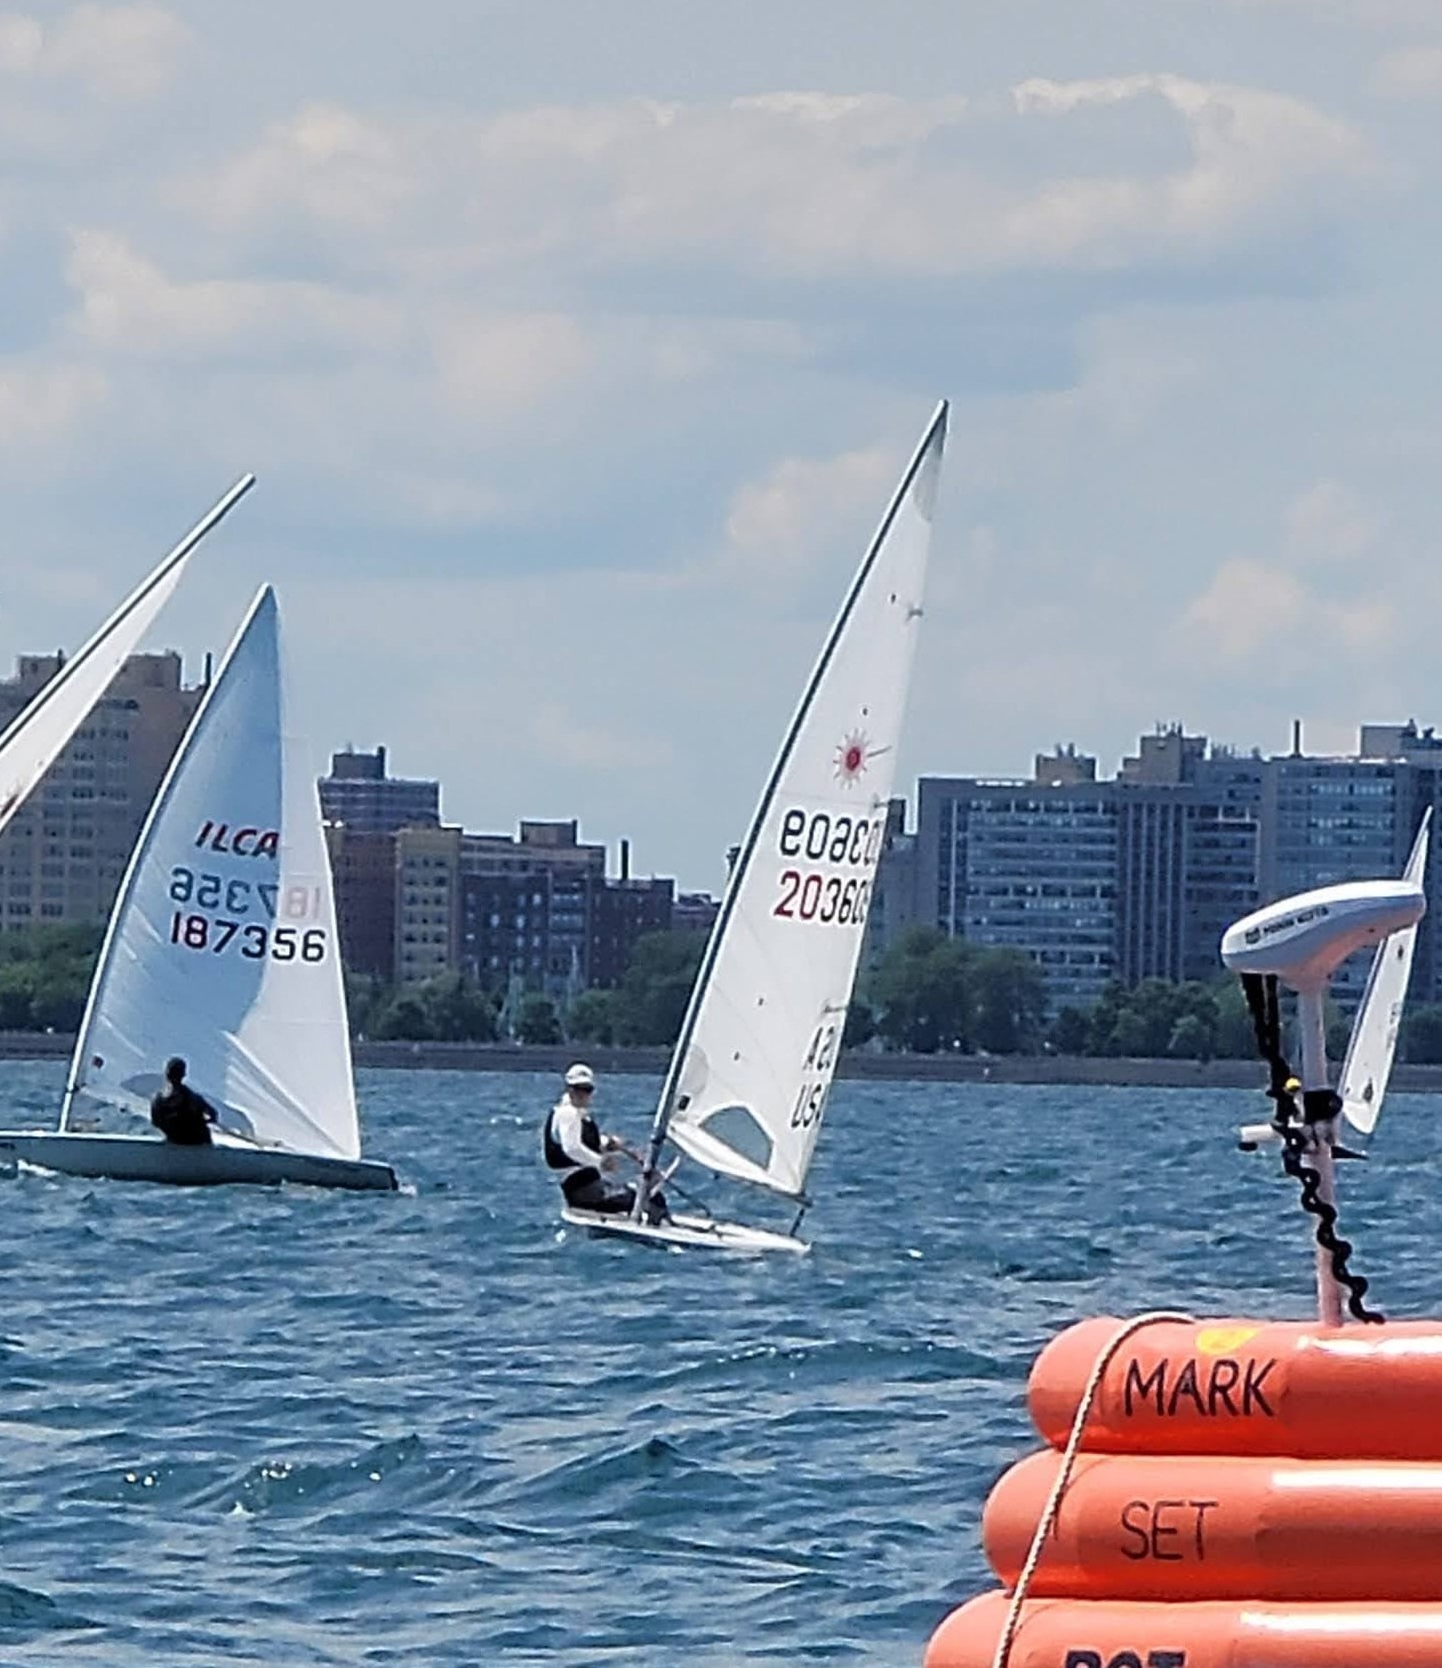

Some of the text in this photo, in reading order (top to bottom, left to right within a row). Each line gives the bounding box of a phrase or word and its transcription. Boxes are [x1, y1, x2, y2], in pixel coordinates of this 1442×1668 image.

[194, 820, 280, 859] ILCA
[171, 911, 326, 962] 187356
[1123, 1358, 1278, 1418] MARK
[1120, 1500, 1219, 1561] SET
